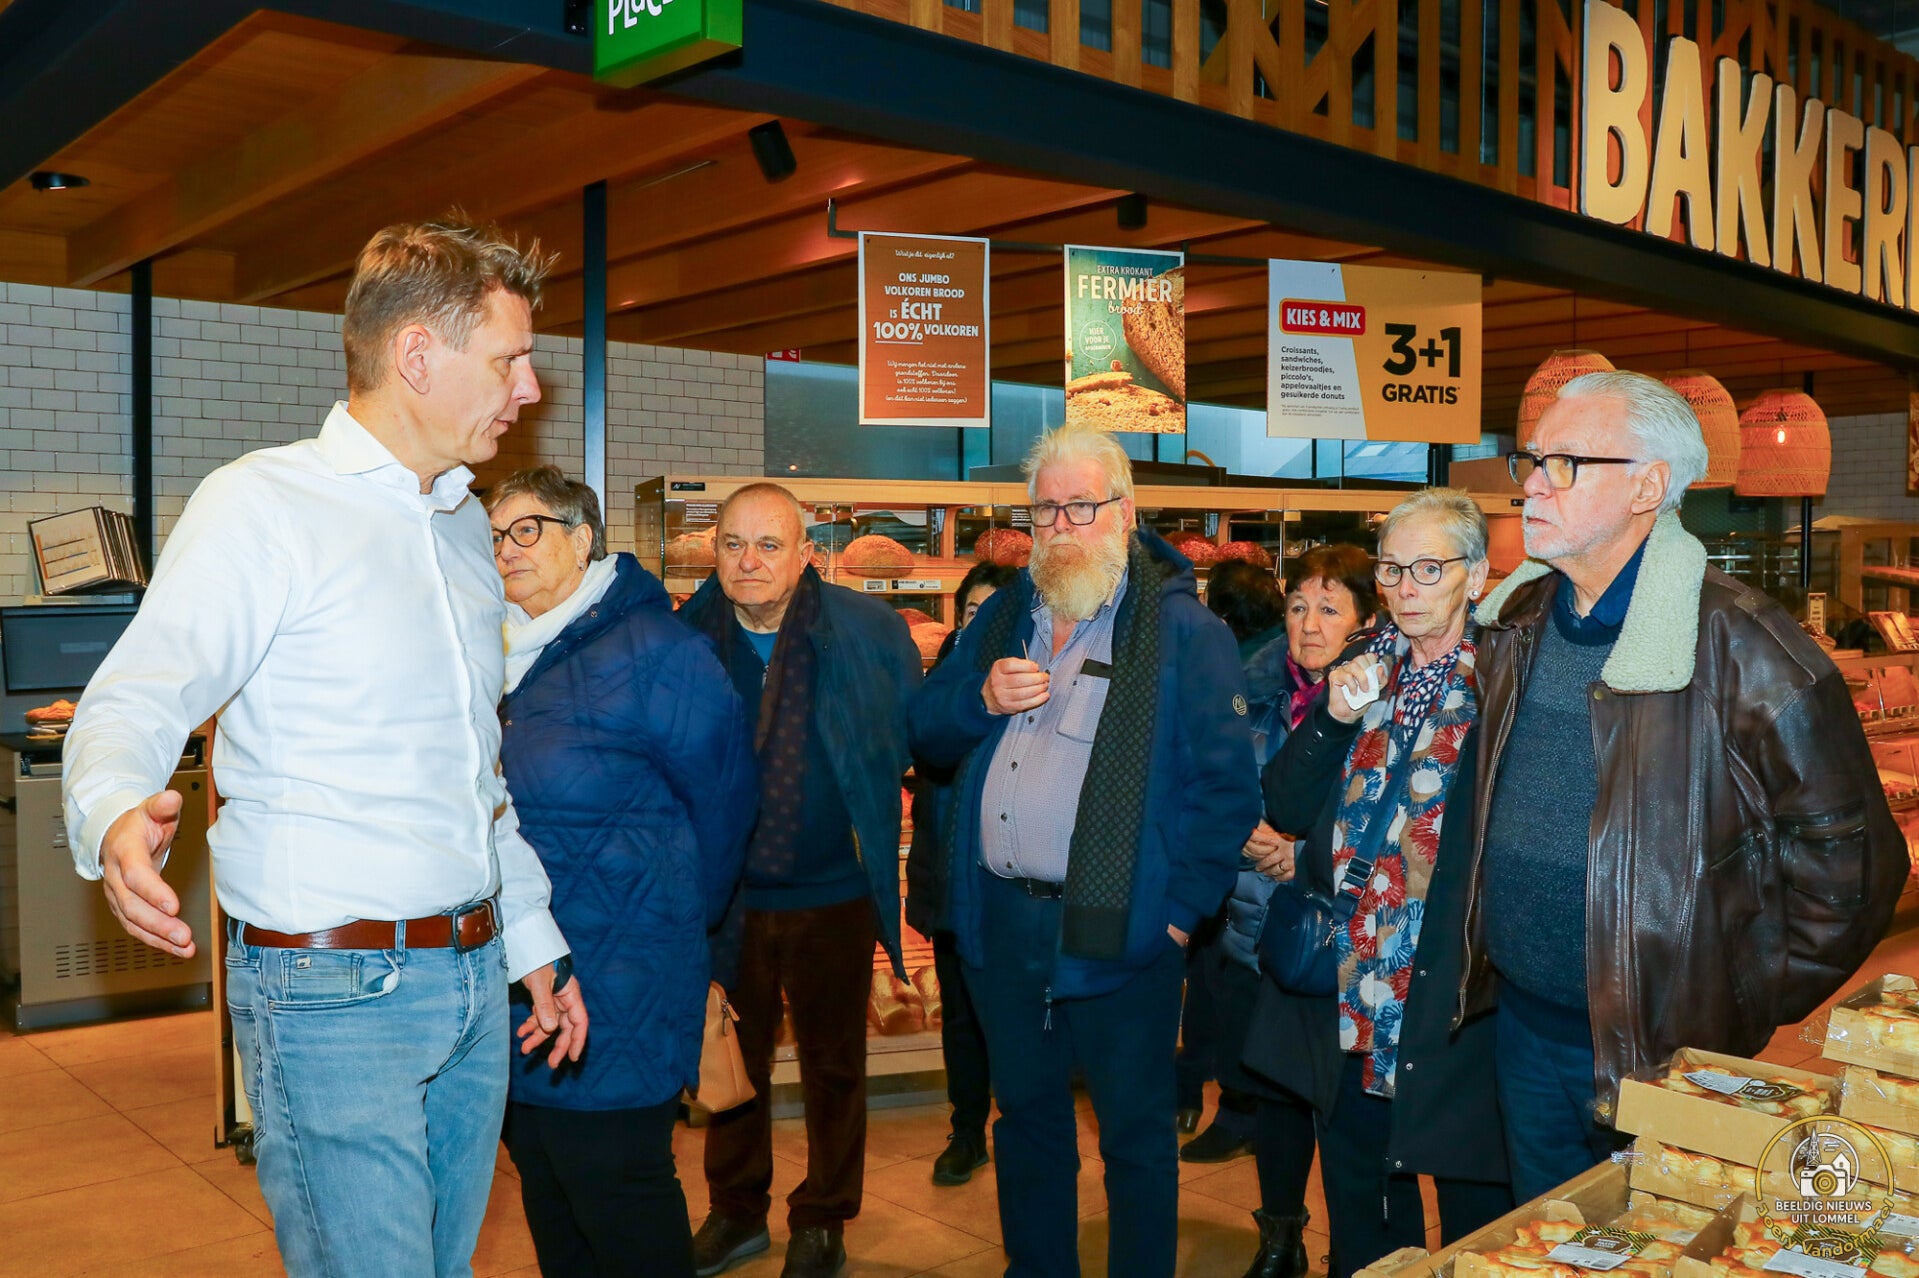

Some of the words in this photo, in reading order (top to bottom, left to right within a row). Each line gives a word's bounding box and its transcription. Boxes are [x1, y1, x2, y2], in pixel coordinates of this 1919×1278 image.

[1097, 265, 1120, 275] EXTRA
[1120, 267, 1154, 277] KROKANT
[898, 272, 917, 283] ONS
[919, 273, 950, 284] JUMBO
[885, 285, 931, 297] VOLKOREN
[933, 287, 965, 299] BROOD
[1078, 275, 1173, 303] FERMIER
[889, 308, 898, 319] IS
[901, 297, 942, 321] ÉCHT
[1108, 301, 1143, 315] brood
[1286, 308, 1317, 327] KIES
[1319, 309, 1331, 328] &
[1332, 310, 1361, 329] MIX
[873, 321, 924, 340] 100%
[923, 323, 979, 337] VOLKOREN
[1281, 345, 1320, 356] Croissants,
[1383, 322, 1461, 378] 3+1
[1281, 355, 1324, 365] sandwiches,
[1281, 364, 1335, 374] keizerbroodjes,
[1280, 373, 1314, 382] piccolo's,
[1280, 390, 1320, 400] gesuikerde
[1320, 391, 1346, 400] donuts
